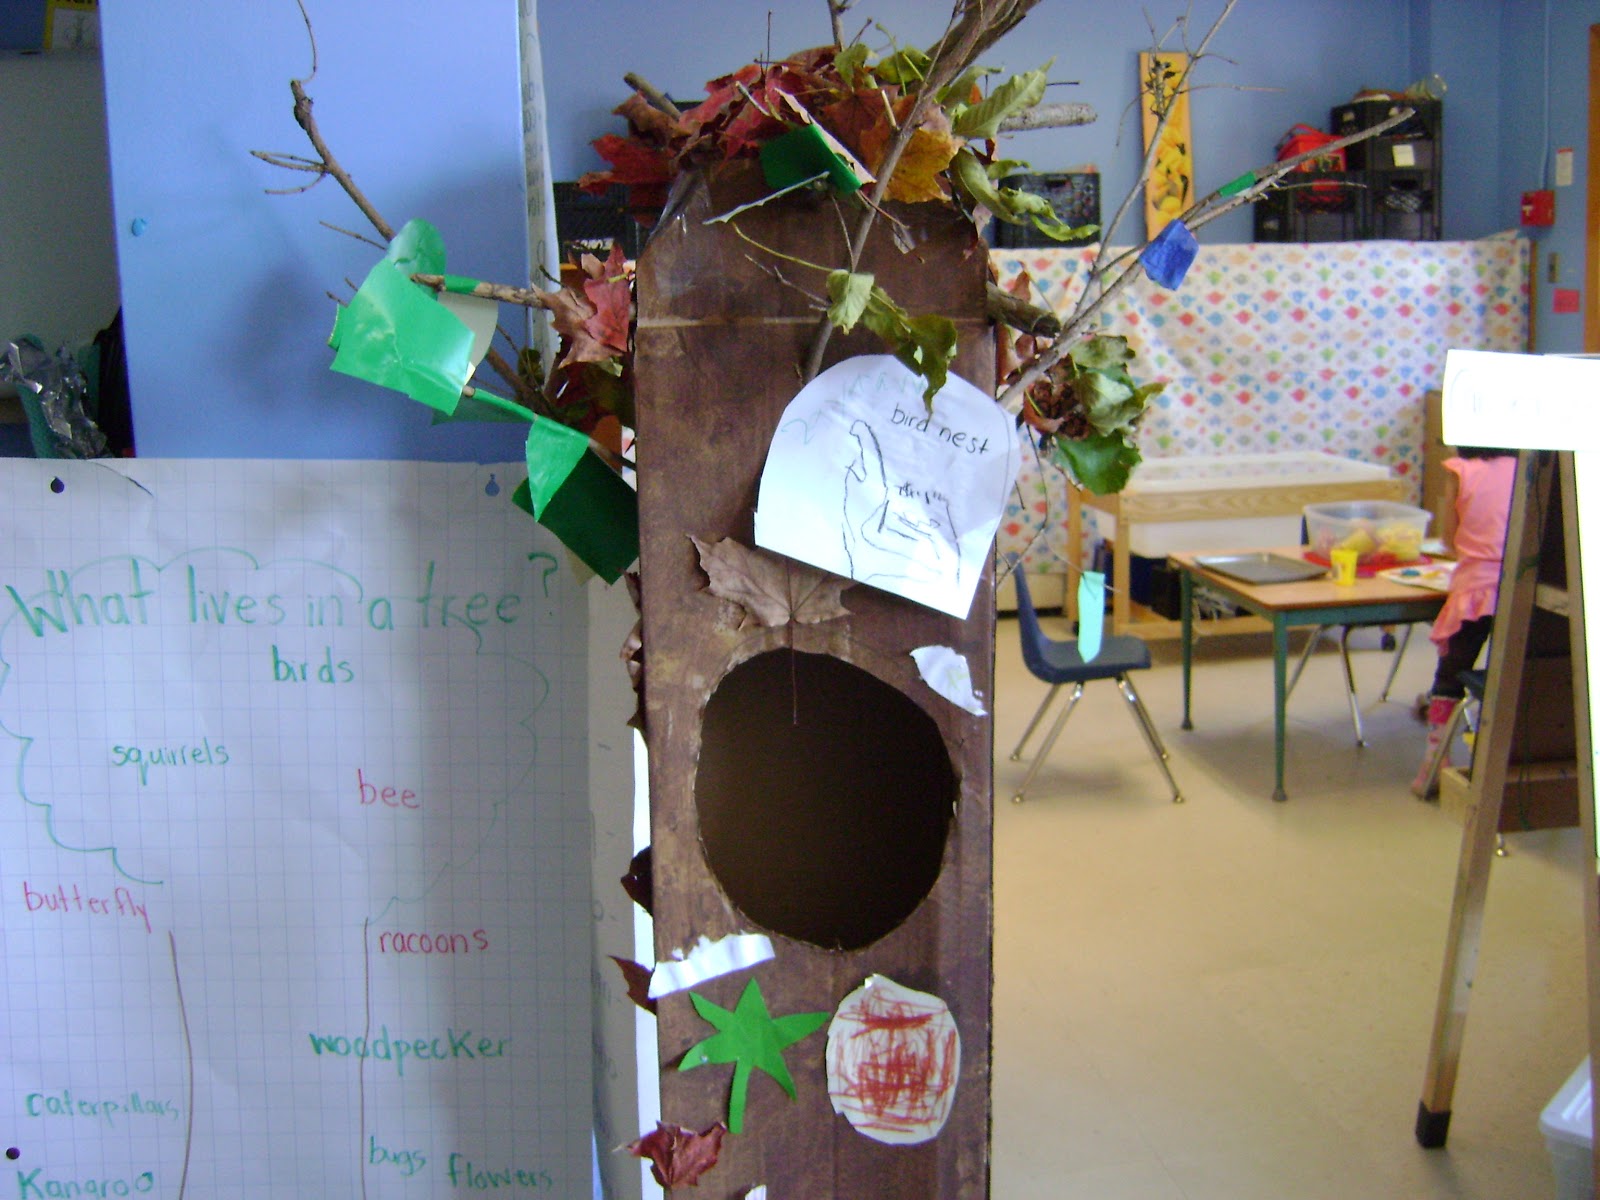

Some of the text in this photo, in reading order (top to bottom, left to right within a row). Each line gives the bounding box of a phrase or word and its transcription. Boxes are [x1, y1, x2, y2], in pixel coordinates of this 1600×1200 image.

[891, 402, 990, 455] bird nest
[5, 557, 154, 638] What
[187, 563, 286, 625] lives
[306, 594, 344, 627] in
[367, 597, 394, 631] a
[272, 644, 355, 683] birds
[112, 737, 230, 786] squirrels
[357, 768, 419, 810] bee
[23, 880, 152, 934] butterfly
[379, 928, 490, 955] racoons
[369, 1135, 426, 1176] bugs
[448, 1152, 553, 1191] flowers
